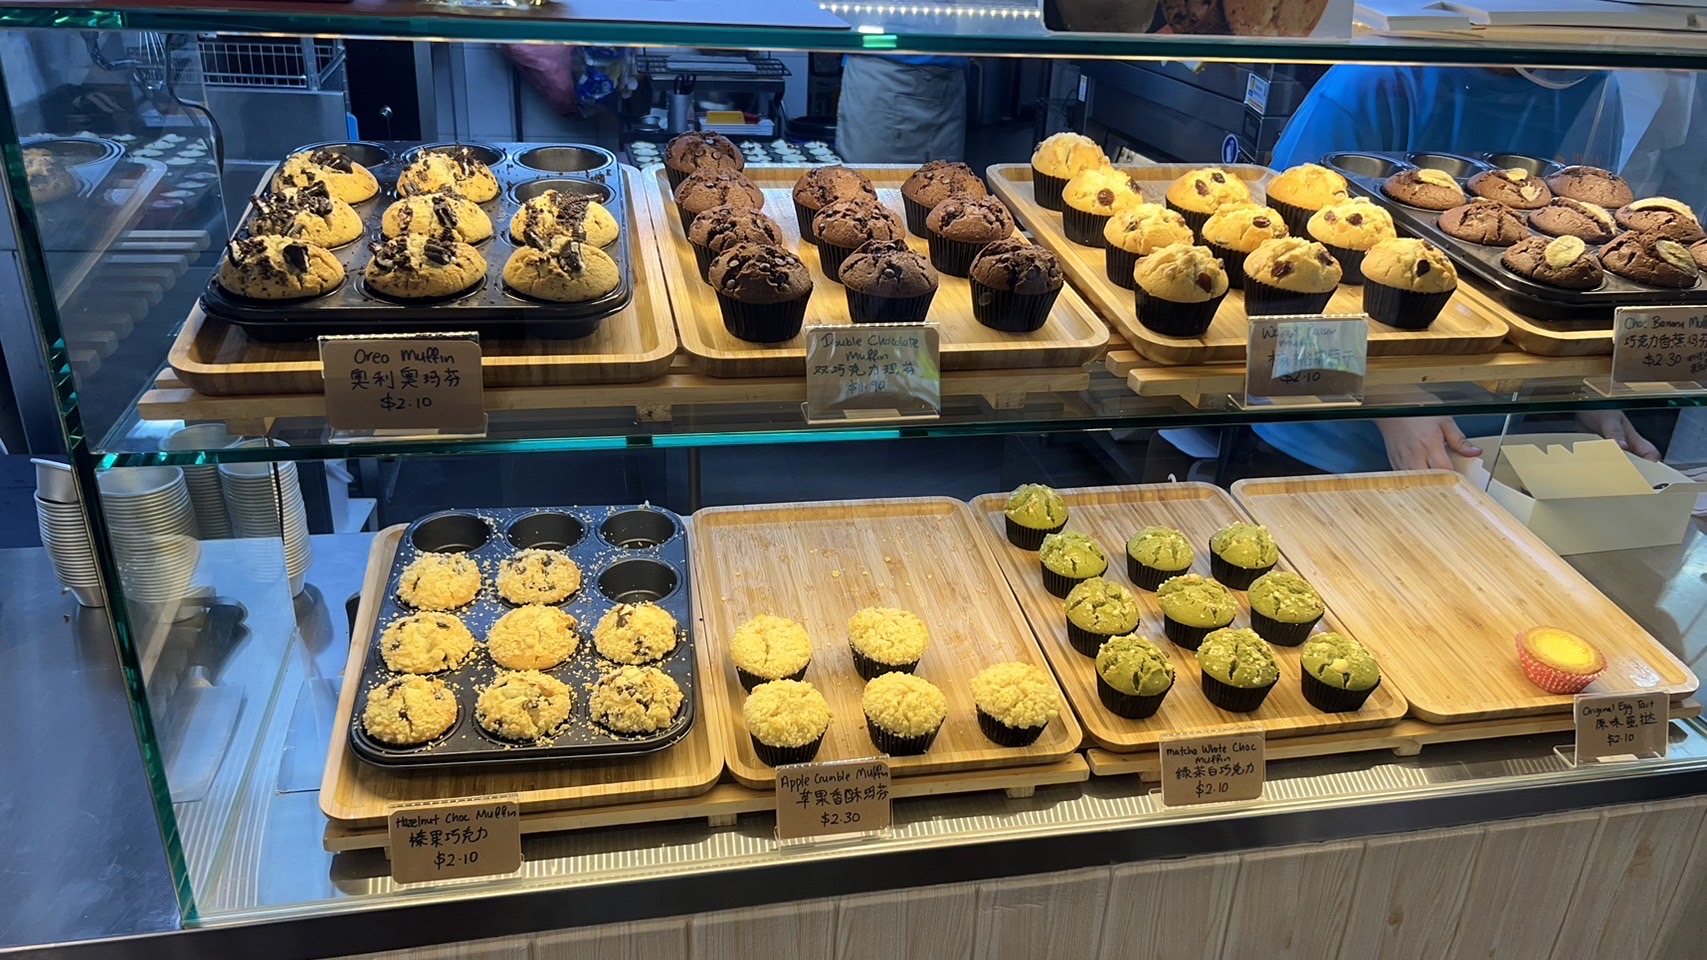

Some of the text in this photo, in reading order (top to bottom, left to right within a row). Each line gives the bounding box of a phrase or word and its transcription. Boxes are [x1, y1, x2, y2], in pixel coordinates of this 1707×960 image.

[1624, 317, 1648, 329] Choc
[1651, 315, 1685, 329] Banana
[821, 332, 920, 348] Double Chocolate
[354, 348, 390, 364] Oreo
[1642, 352, 1682, 367] $2.30
[350, 366, 461, 390] 奥利奥玛芬
[1280, 371, 1321, 384] $2.10
[848, 379, 886, 395] $1.90
[380, 393, 432, 411] $2.10
[1582, 699, 1655, 717] Original Egg Tart
[1595, 712, 1658, 730] 原味蛋挞
[1201, 743, 1227, 754] White
[1232, 742, 1257, 752] Choc
[1607, 733, 1635, 746] $2.10
[1175, 762, 1255, 780] 绿茶白巧克力
[780, 774, 811, 793] Apple
[814, 769, 851, 784] Crumble
[1195, 780, 1229, 798] $2.10
[395, 805, 517, 829] Hazelnut Choc Muffin
[820, 811, 861, 828] $2.30
[409, 825, 488, 848] 榛果巧克力
[434, 851, 478, 870] $2.10
